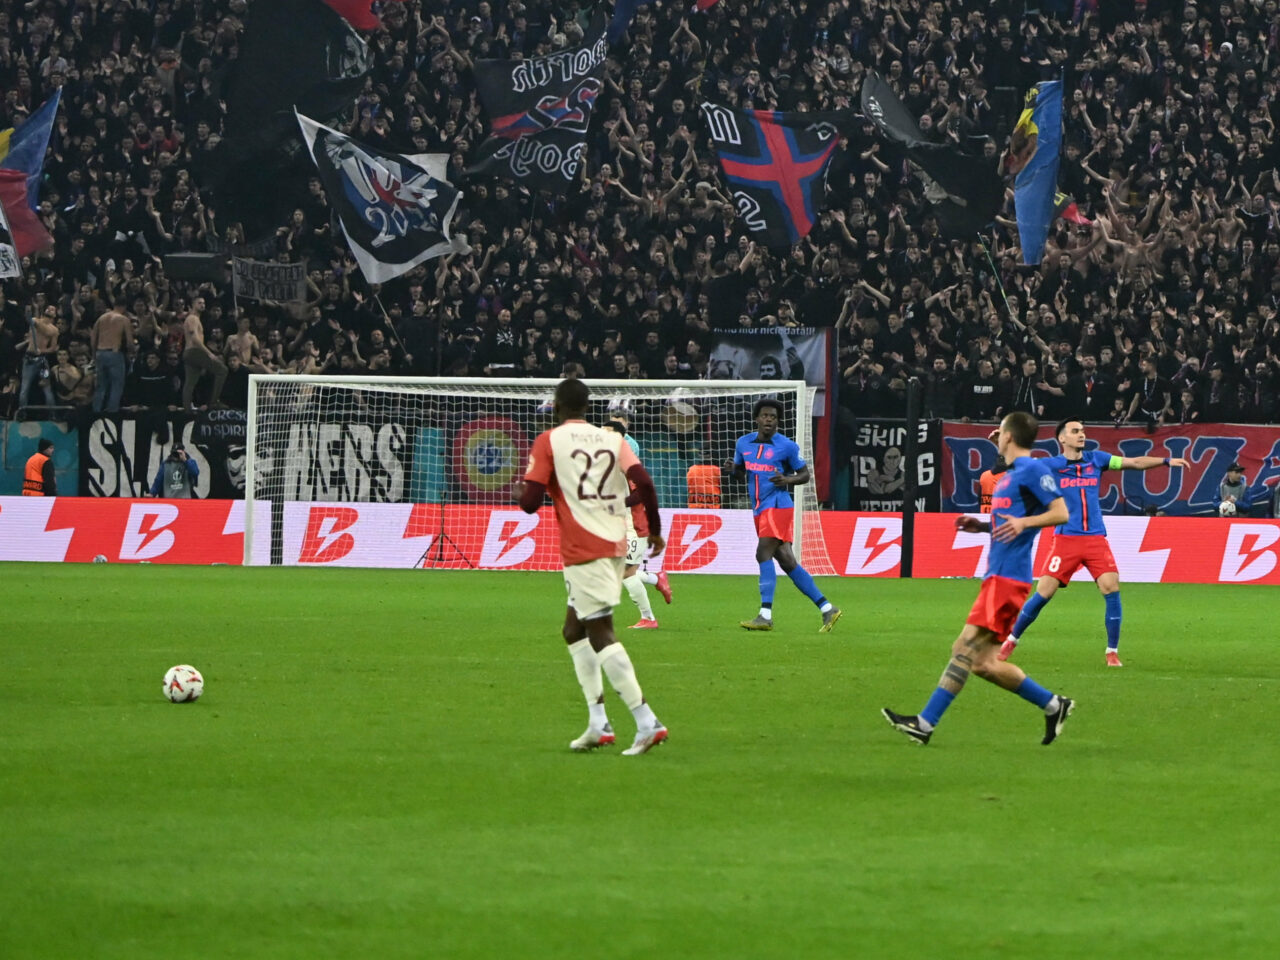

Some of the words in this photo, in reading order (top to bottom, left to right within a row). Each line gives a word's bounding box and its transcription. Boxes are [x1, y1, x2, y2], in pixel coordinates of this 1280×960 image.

[570, 448, 617, 501] 22
[850, 452, 935, 488] 196
[1048, 555, 1062, 573] 8
